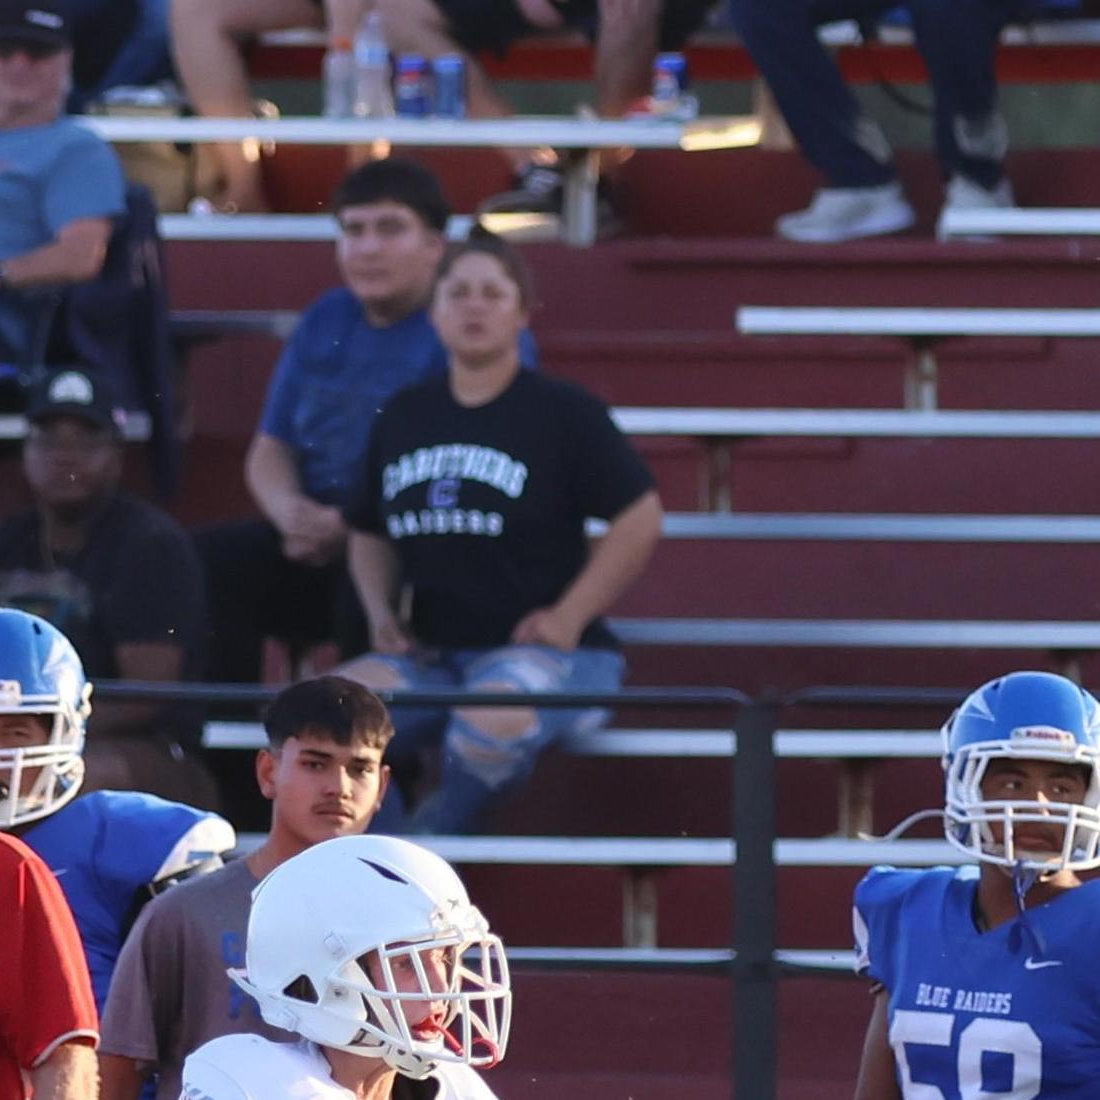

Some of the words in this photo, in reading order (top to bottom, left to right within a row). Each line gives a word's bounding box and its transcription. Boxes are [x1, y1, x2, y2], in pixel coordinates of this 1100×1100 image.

[387, 508, 504, 539] RAIDERS
[915, 983, 951, 1008] BLUE
[953, 989, 1012, 1015] RAIDERS
